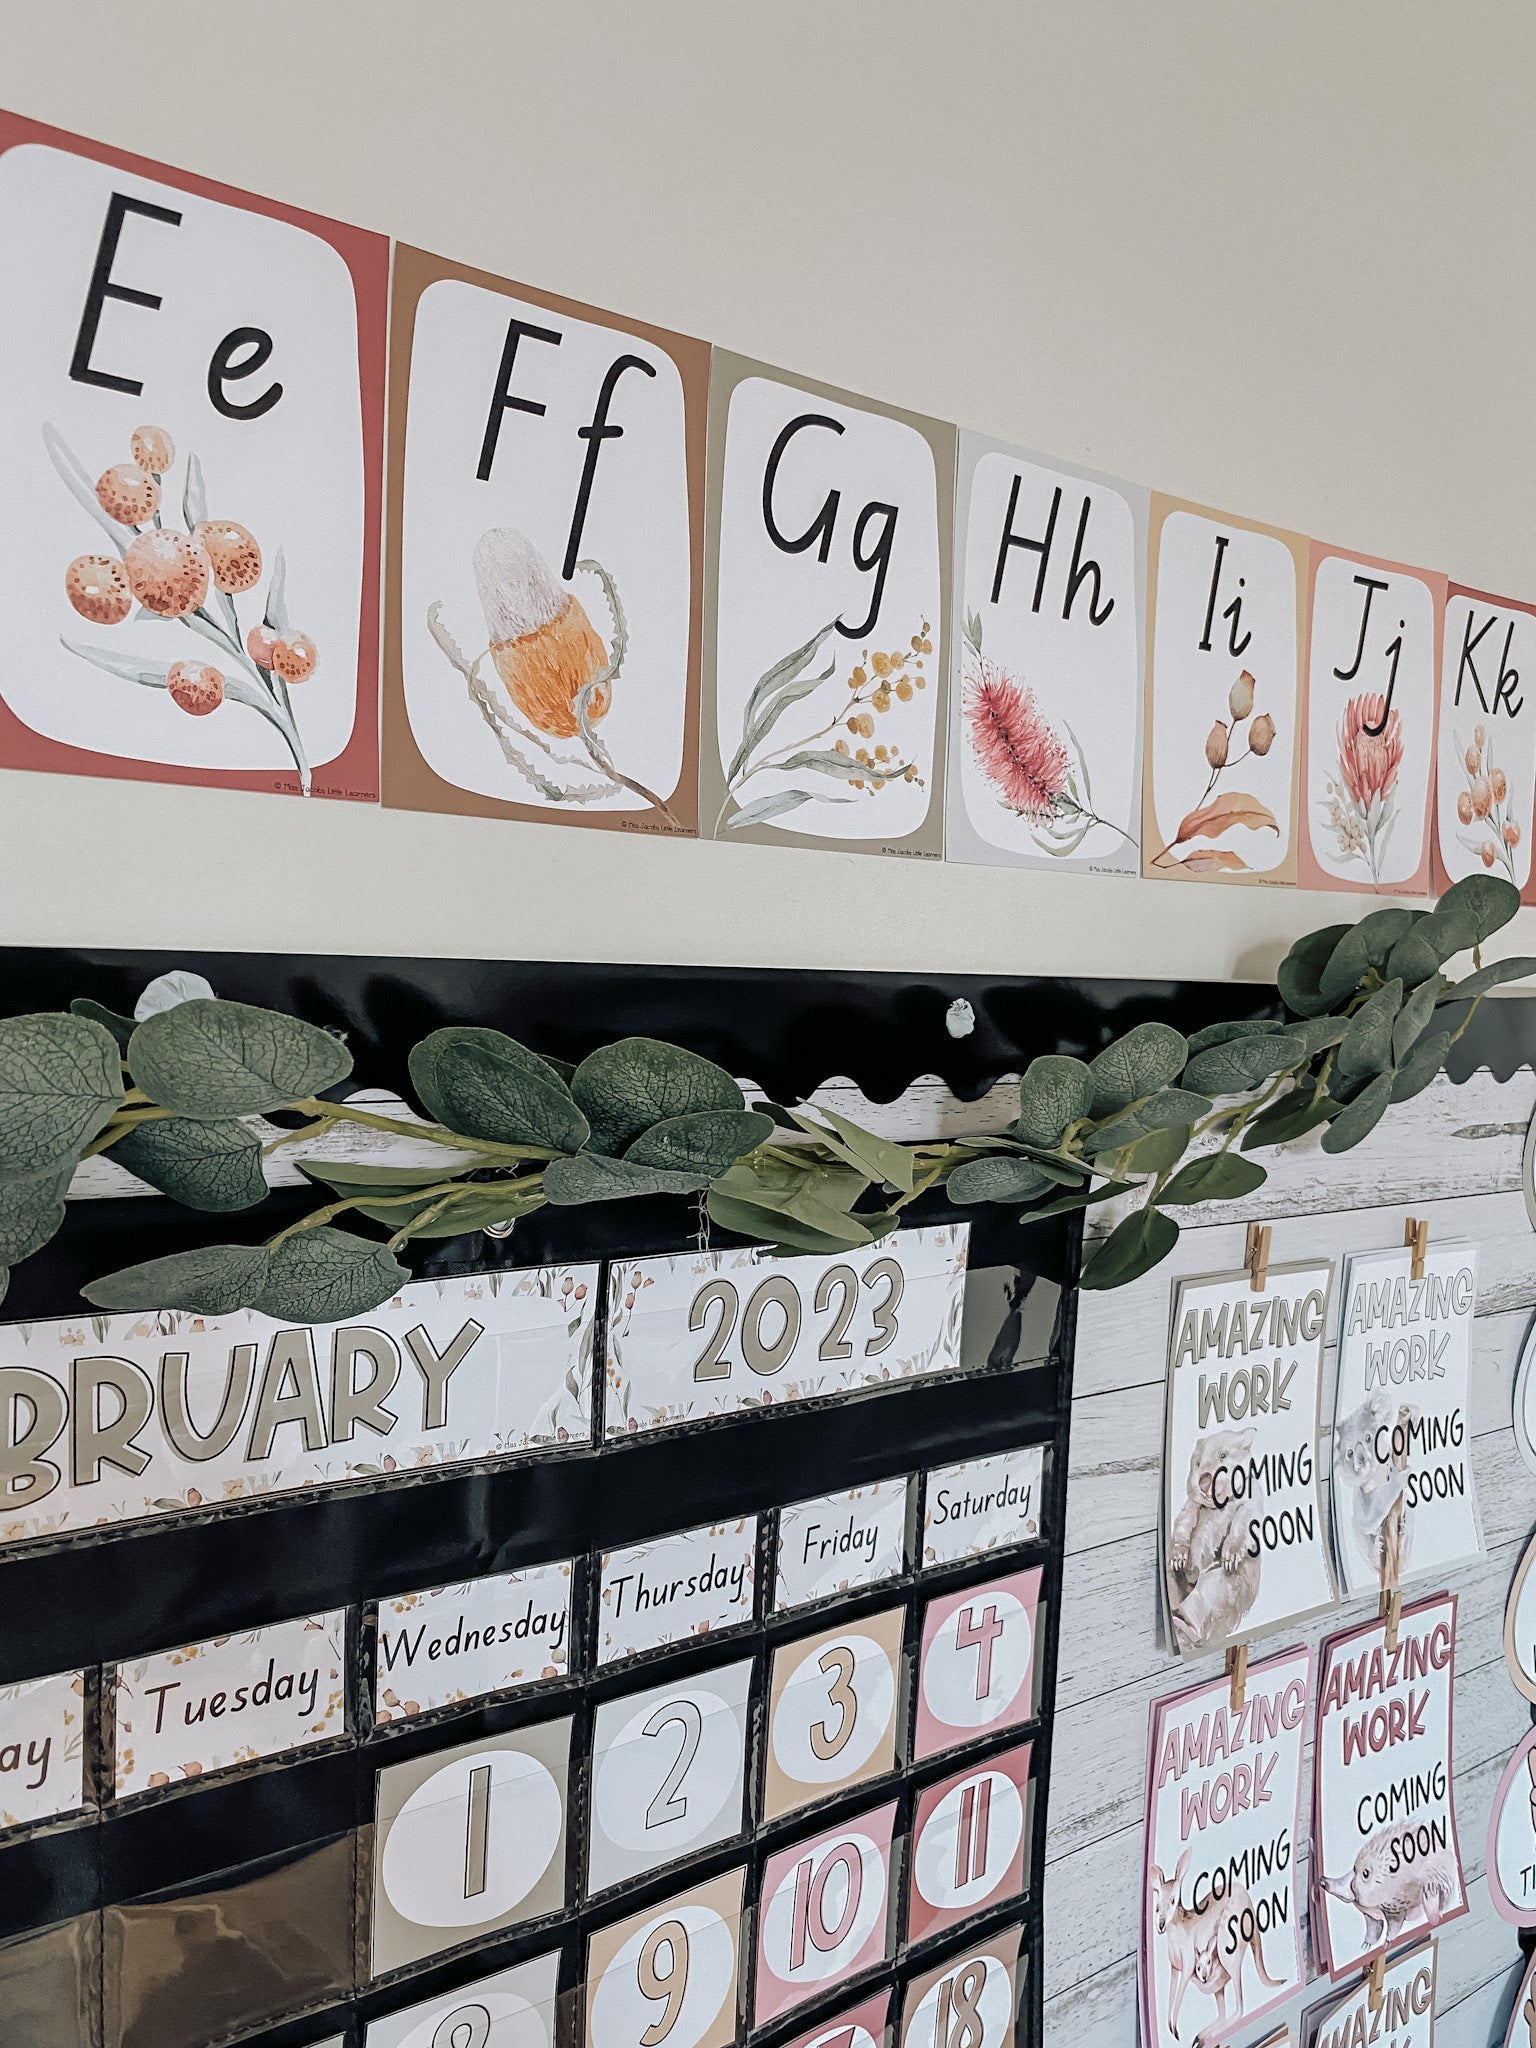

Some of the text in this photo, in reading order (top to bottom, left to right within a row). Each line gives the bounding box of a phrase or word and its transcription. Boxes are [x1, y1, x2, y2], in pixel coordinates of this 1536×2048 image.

[761, 412, 900, 640] Gg
[990, 474, 1116, 627] Hh
[1333, 575, 1406, 736] Jj
[1453, 609, 1524, 719] Kk
[688, 1256, 905, 1383] 2023
[1175, 1288, 1325, 1368] AMAZING
[1347, 1267, 1474, 1337] AMAZING
[1199, 1358, 1298, 1428] WORK
[1364, 1329, 1451, 1391] WORK
[1211, 1442, 1313, 1509] COMING
[1374, 1408, 1465, 1464] COMING
[932, 1474, 1031, 1529] Saturday
[1406, 1462, 1465, 1509] SOON
[803, 1516, 878, 1565] Friday
[1247, 1504, 1314, 1559] SOON
[609, 1553, 746, 1618] Thursday
[382, 1599, 567, 1672] Wednesday
[954, 1607, 1003, 1699] 4
[144, 1657, 320, 1736] Tuesday
[810, 1647, 857, 1761] 3
[1158, 1678, 1307, 1789] AMAZING
[1344, 1688, 1431, 1766] WORK
[0, 1737, 51, 1789] ay
[643, 1700, 702, 1829] 2
[1180, 1751, 1279, 1841] WORK
[1357, 1761, 1446, 1836] COMING
[954, 1779, 993, 1889] 11
[1192, 1828, 1290, 1916] COMING
[1389, 1815, 1447, 1873] SOON
[790, 1842, 862, 1972] 10
[1225, 1890, 1288, 1955] SOON
[637, 1920, 690, 2048] 9
[934, 1960, 987, 2048] 18
[1320, 1967, 1432, 2048] MAZING
